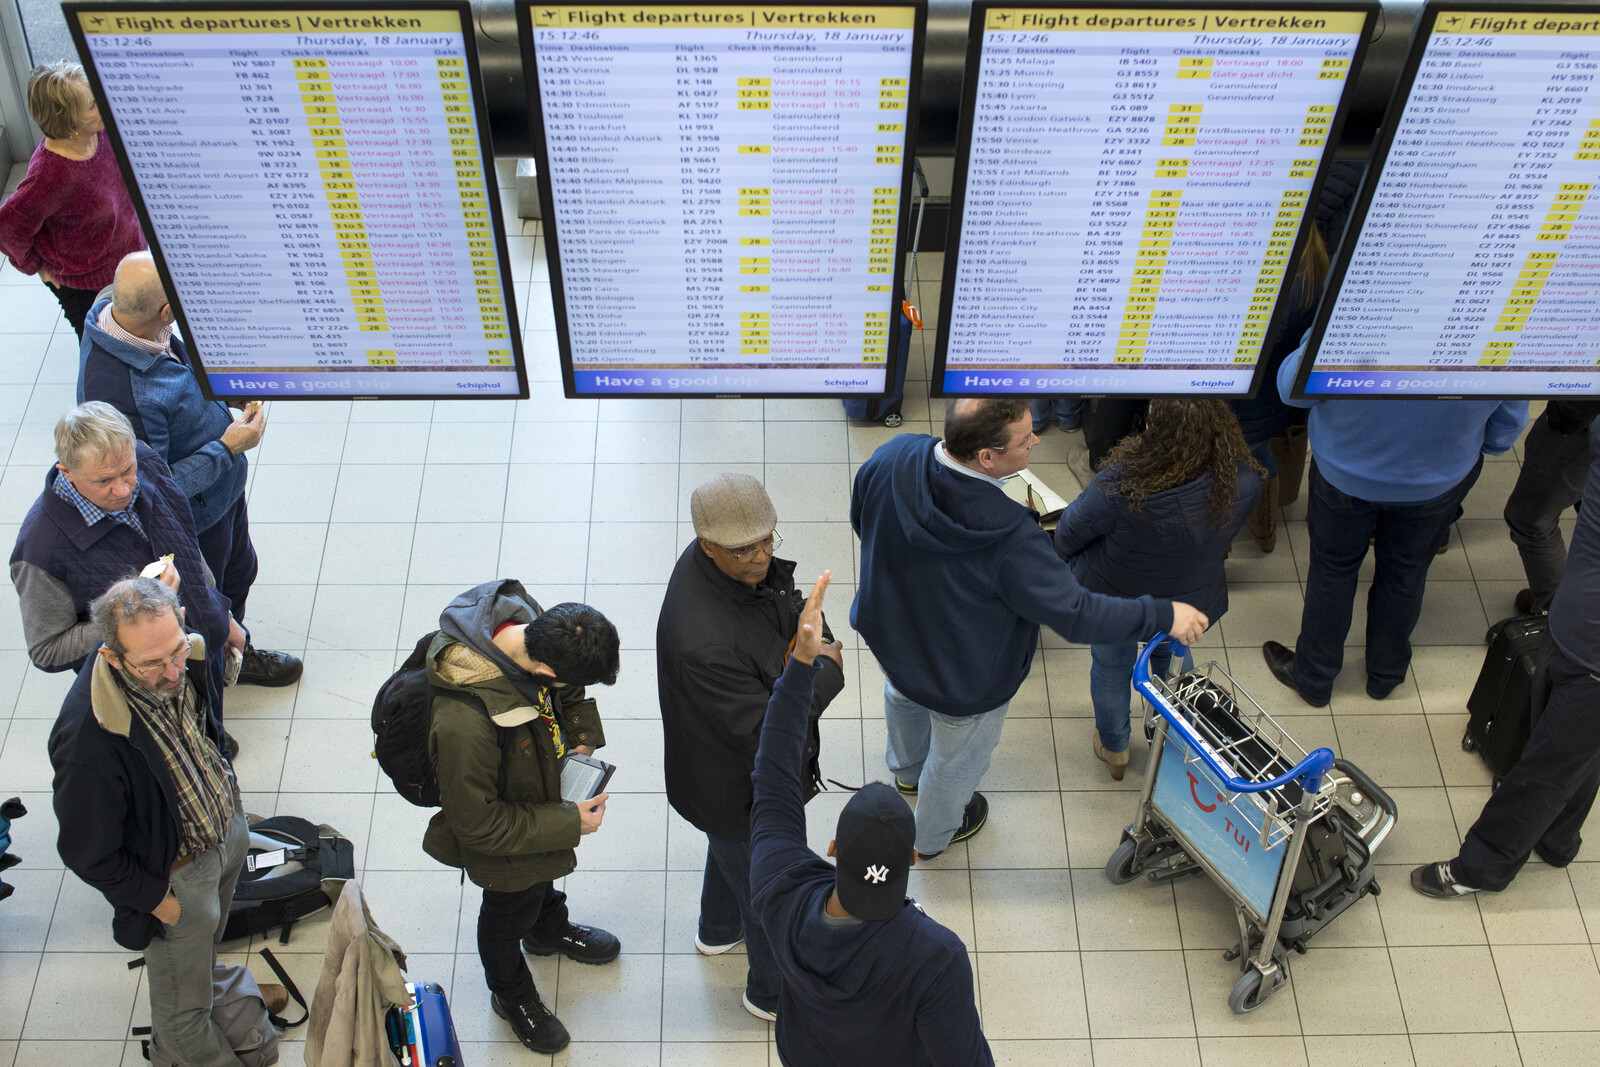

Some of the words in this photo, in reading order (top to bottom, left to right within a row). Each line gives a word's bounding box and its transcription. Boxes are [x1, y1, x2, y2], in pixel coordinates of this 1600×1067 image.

[115, 17, 175, 32] Flight
[180, 17, 291, 31] departures
[307, 16, 421, 28] Vertrekken
[568, 11, 625, 25] Flight
[633, 11, 744, 25] departures
[762, 11, 876, 23] Vertrekken
[1022, 14, 1079, 29] Flight
[1086, 14, 1196, 29] departures
[1215, 16, 1326, 28] Vertrekken
[1470, 18, 1527, 32] Flight
[91, 37, 152, 46] 15:12:46
[296, 36, 367, 46] Thursday,
[374, 36, 390, 44] 18
[395, 36, 453, 46] January
[540, 31, 599, 40] 15:12:46
[746, 31, 816, 42] Thursday,
[846, 32, 904, 42] January
[989, 34, 1048, 43] 15:12:46
[1194, 35, 1262, 46] Thursday,
[1271, 36, 1288, 44] 18
[1291, 37, 1350, 47] January
[1434, 37, 1493, 46] 15:12:46
[229, 380, 279, 389] Have
[302, 380, 350, 391] good
[358, 379, 391, 390] trip
[596, 376, 645, 386] Have
[668, 376, 718, 388] good
[726, 376, 758, 388] trip
[965, 376, 1013, 386] Have
[1036, 376, 1086, 388] good
[1094, 376, 1126, 388] trip
[1327, 378, 1375, 387] Have
[1397, 378, 1447, 389] good
[1453, 378, 1485, 389] trip
[1225, 817, 1250, 852] TUI
[864, 864, 889, 883] NY
